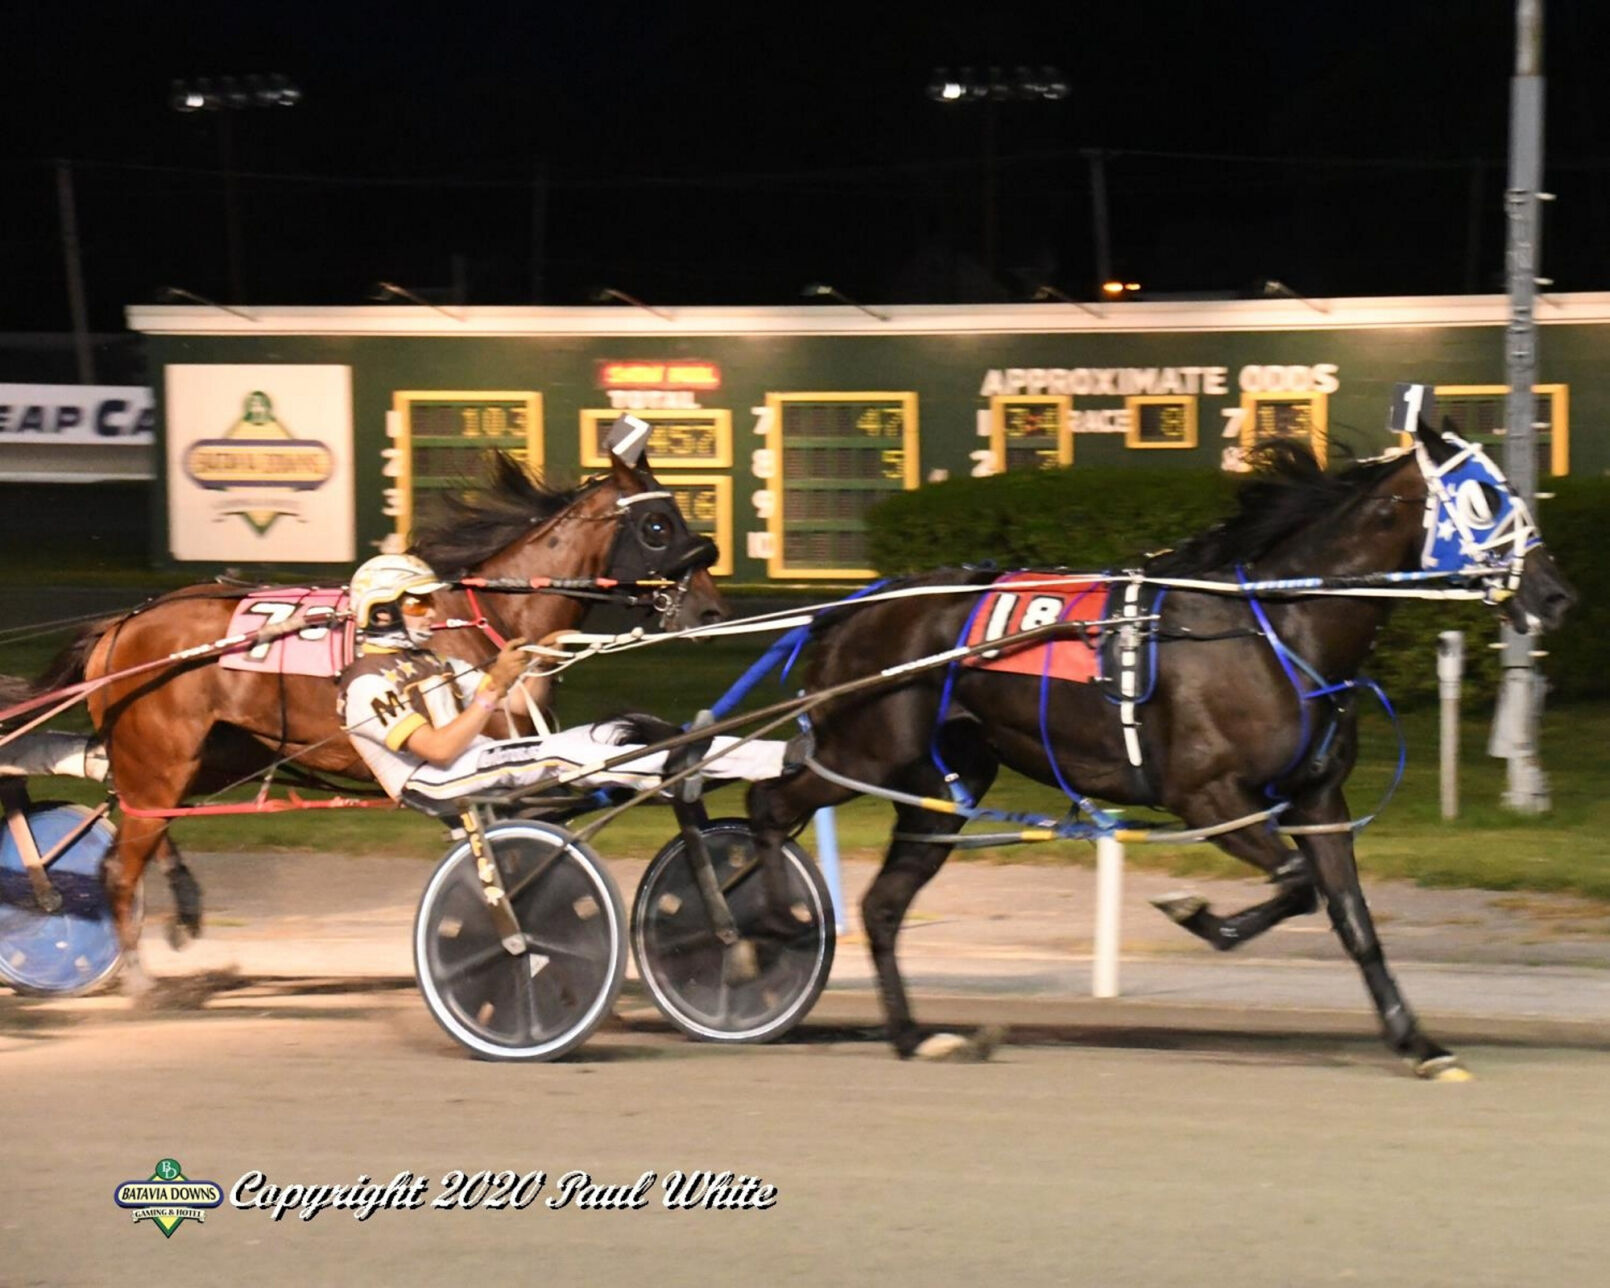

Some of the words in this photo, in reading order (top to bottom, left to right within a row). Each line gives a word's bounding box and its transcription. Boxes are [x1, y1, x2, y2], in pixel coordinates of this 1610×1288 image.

[980, 368, 1228, 396] APPROXIMATE
[1239, 364, 1340, 393] ODDS
[1220, 407, 1249, 438] 7
[1403, 385, 1424, 432] 1
[611, 414, 650, 455] 7
[370, 690, 406, 727] M
